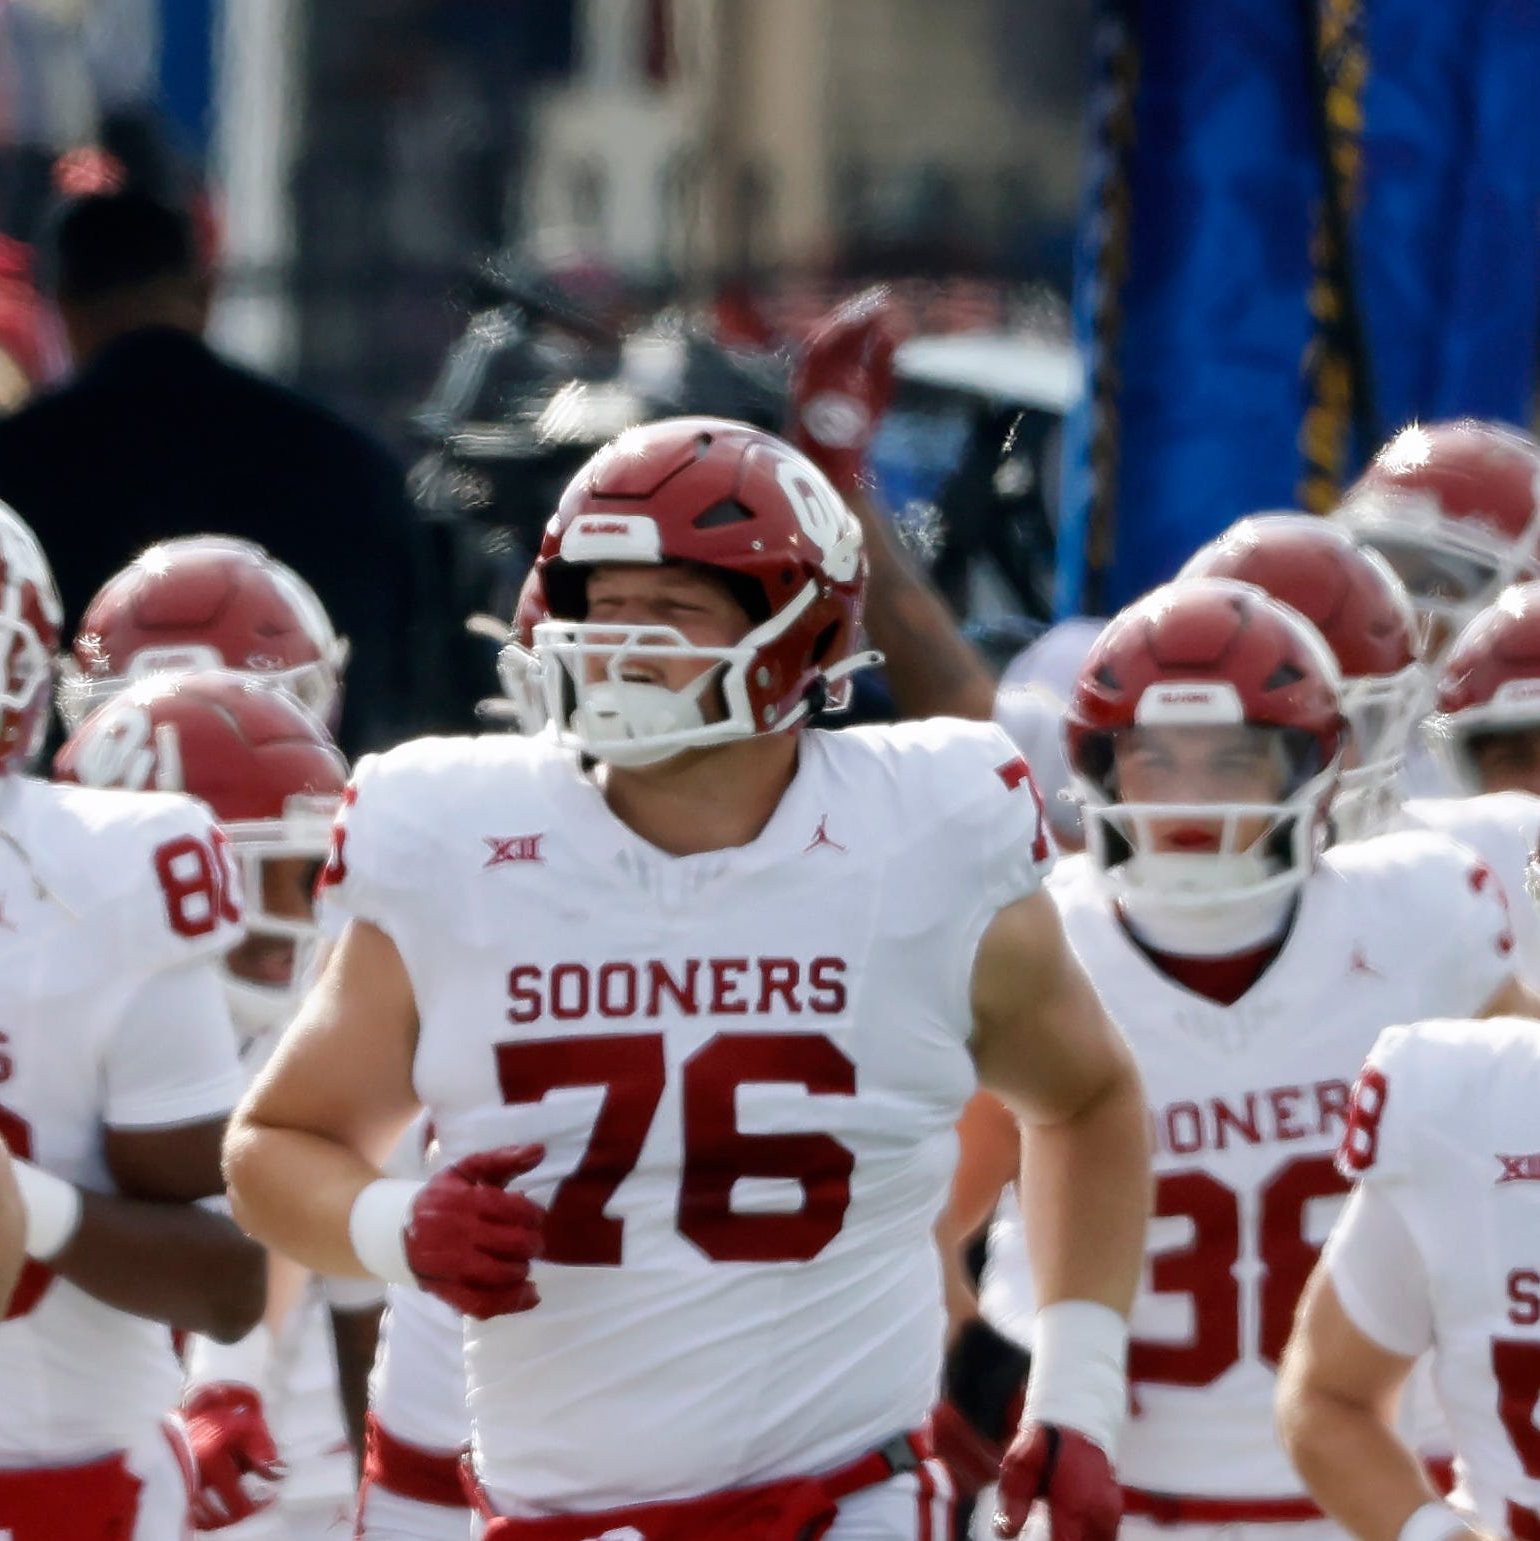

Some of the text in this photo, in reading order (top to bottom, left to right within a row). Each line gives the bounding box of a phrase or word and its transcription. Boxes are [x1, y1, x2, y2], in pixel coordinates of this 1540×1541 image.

[505, 956, 848, 1024] SOONERS
[492, 1031, 857, 1268] 76
[1153, 1078, 1356, 1154] ONER
